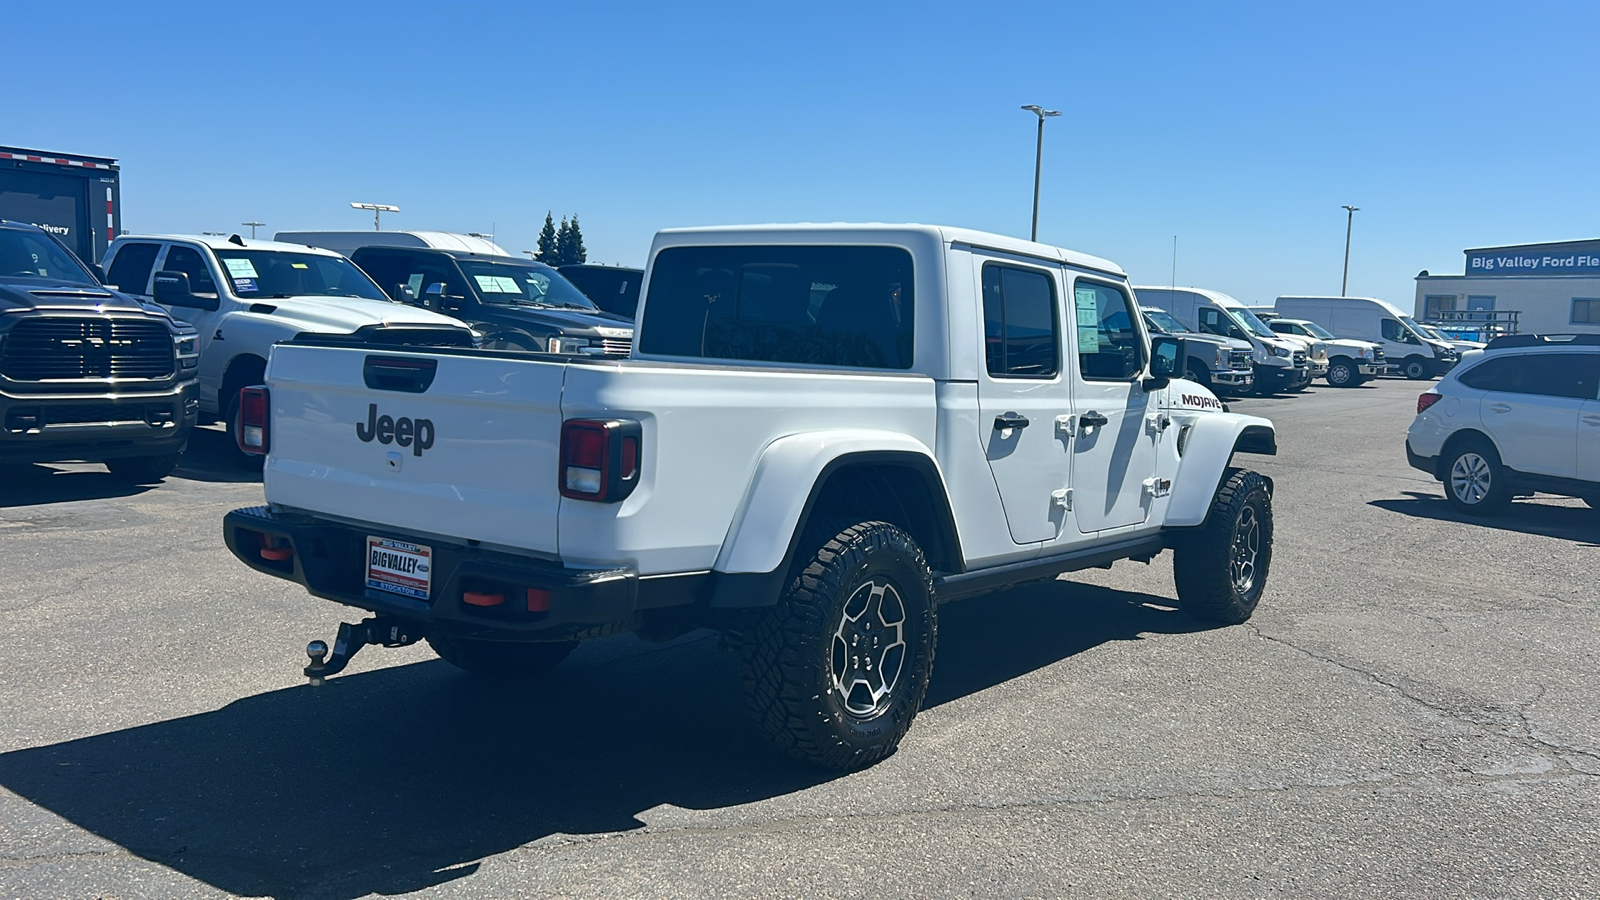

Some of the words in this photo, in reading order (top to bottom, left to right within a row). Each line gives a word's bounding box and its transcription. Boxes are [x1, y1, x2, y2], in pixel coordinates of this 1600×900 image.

[31, 223, 69, 235] livery
[1472, 257, 1494, 270] Big
[1497, 256, 1540, 269] Valley
[1542, 255, 1574, 267] Ford
[1577, 255, 1600, 267] Fle
[1181, 394, 1221, 409] MOJAVE
[356, 403, 435, 457] Jeep
[394, 542, 417, 551] VALLEY
[372, 550, 418, 574] BIGVALLEY
[380, 582, 415, 595] STOCKTON
